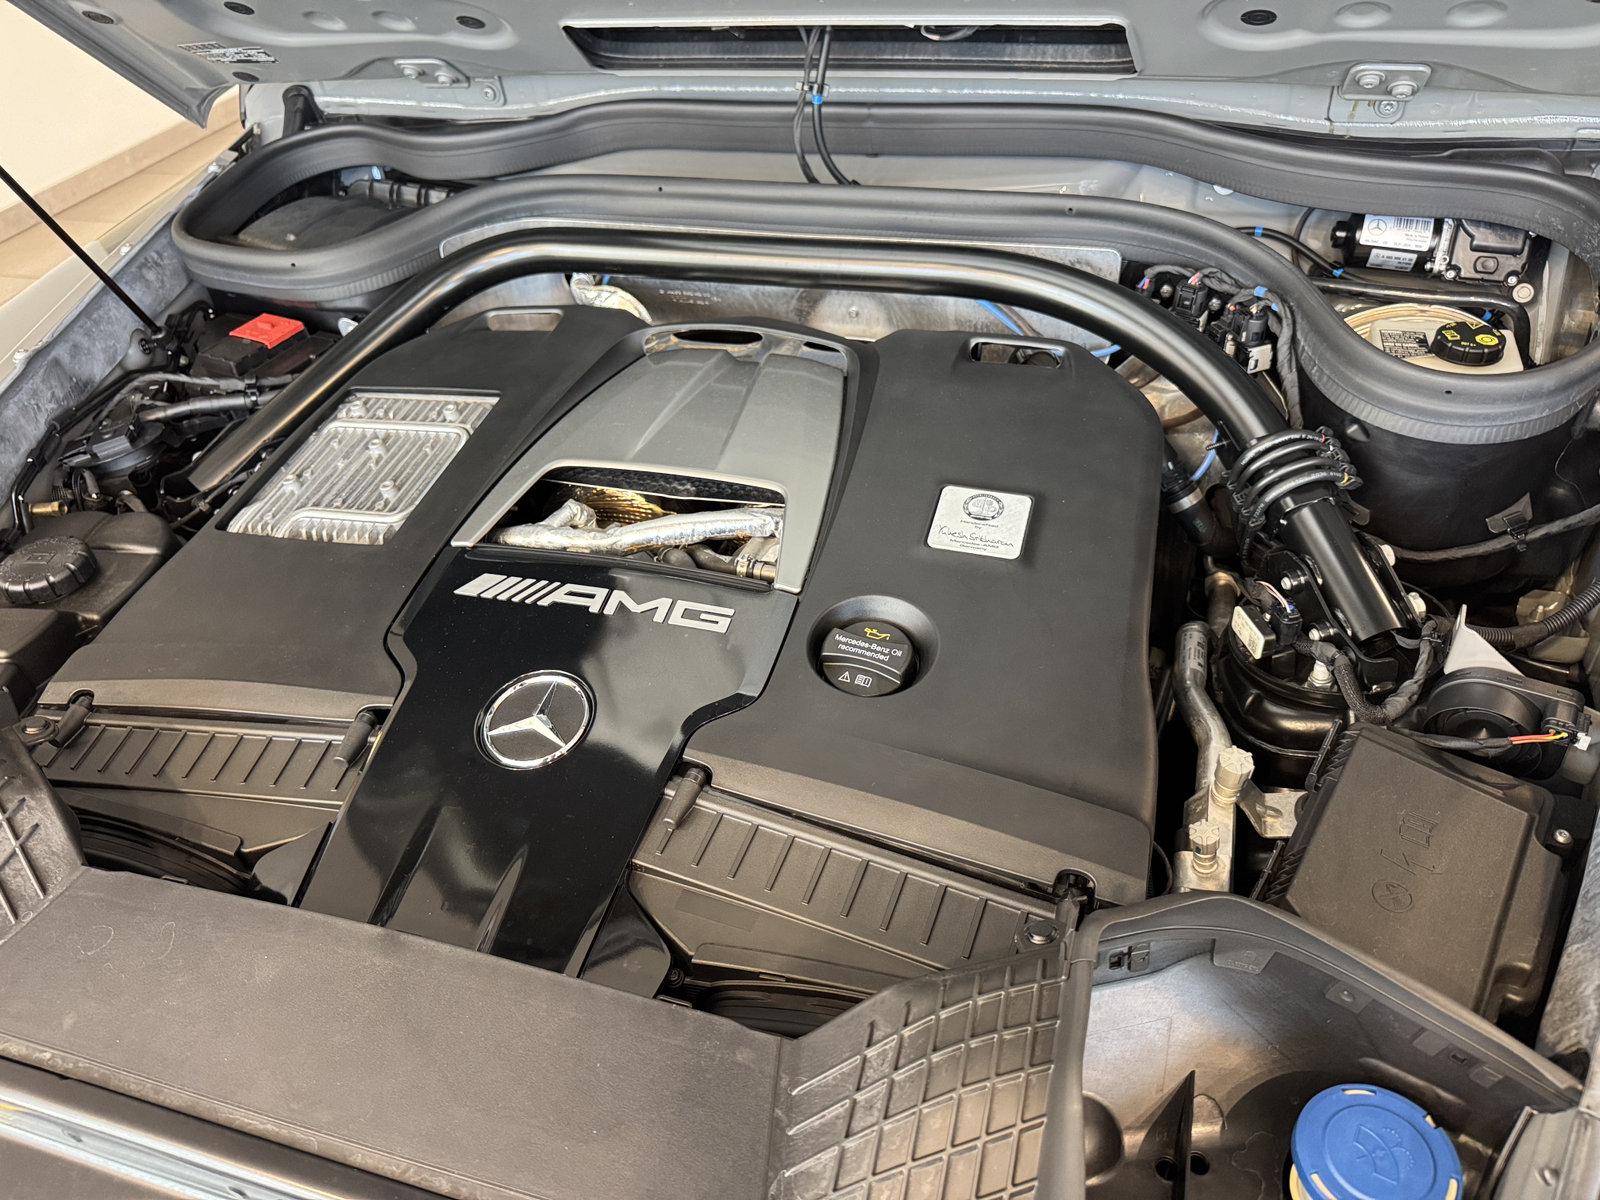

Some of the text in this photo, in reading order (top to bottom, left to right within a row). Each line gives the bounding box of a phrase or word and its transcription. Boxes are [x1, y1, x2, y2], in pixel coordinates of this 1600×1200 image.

[834, 633, 903, 657] Mercedes-Benz Oil
[838, 643, 890, 662] recommended
